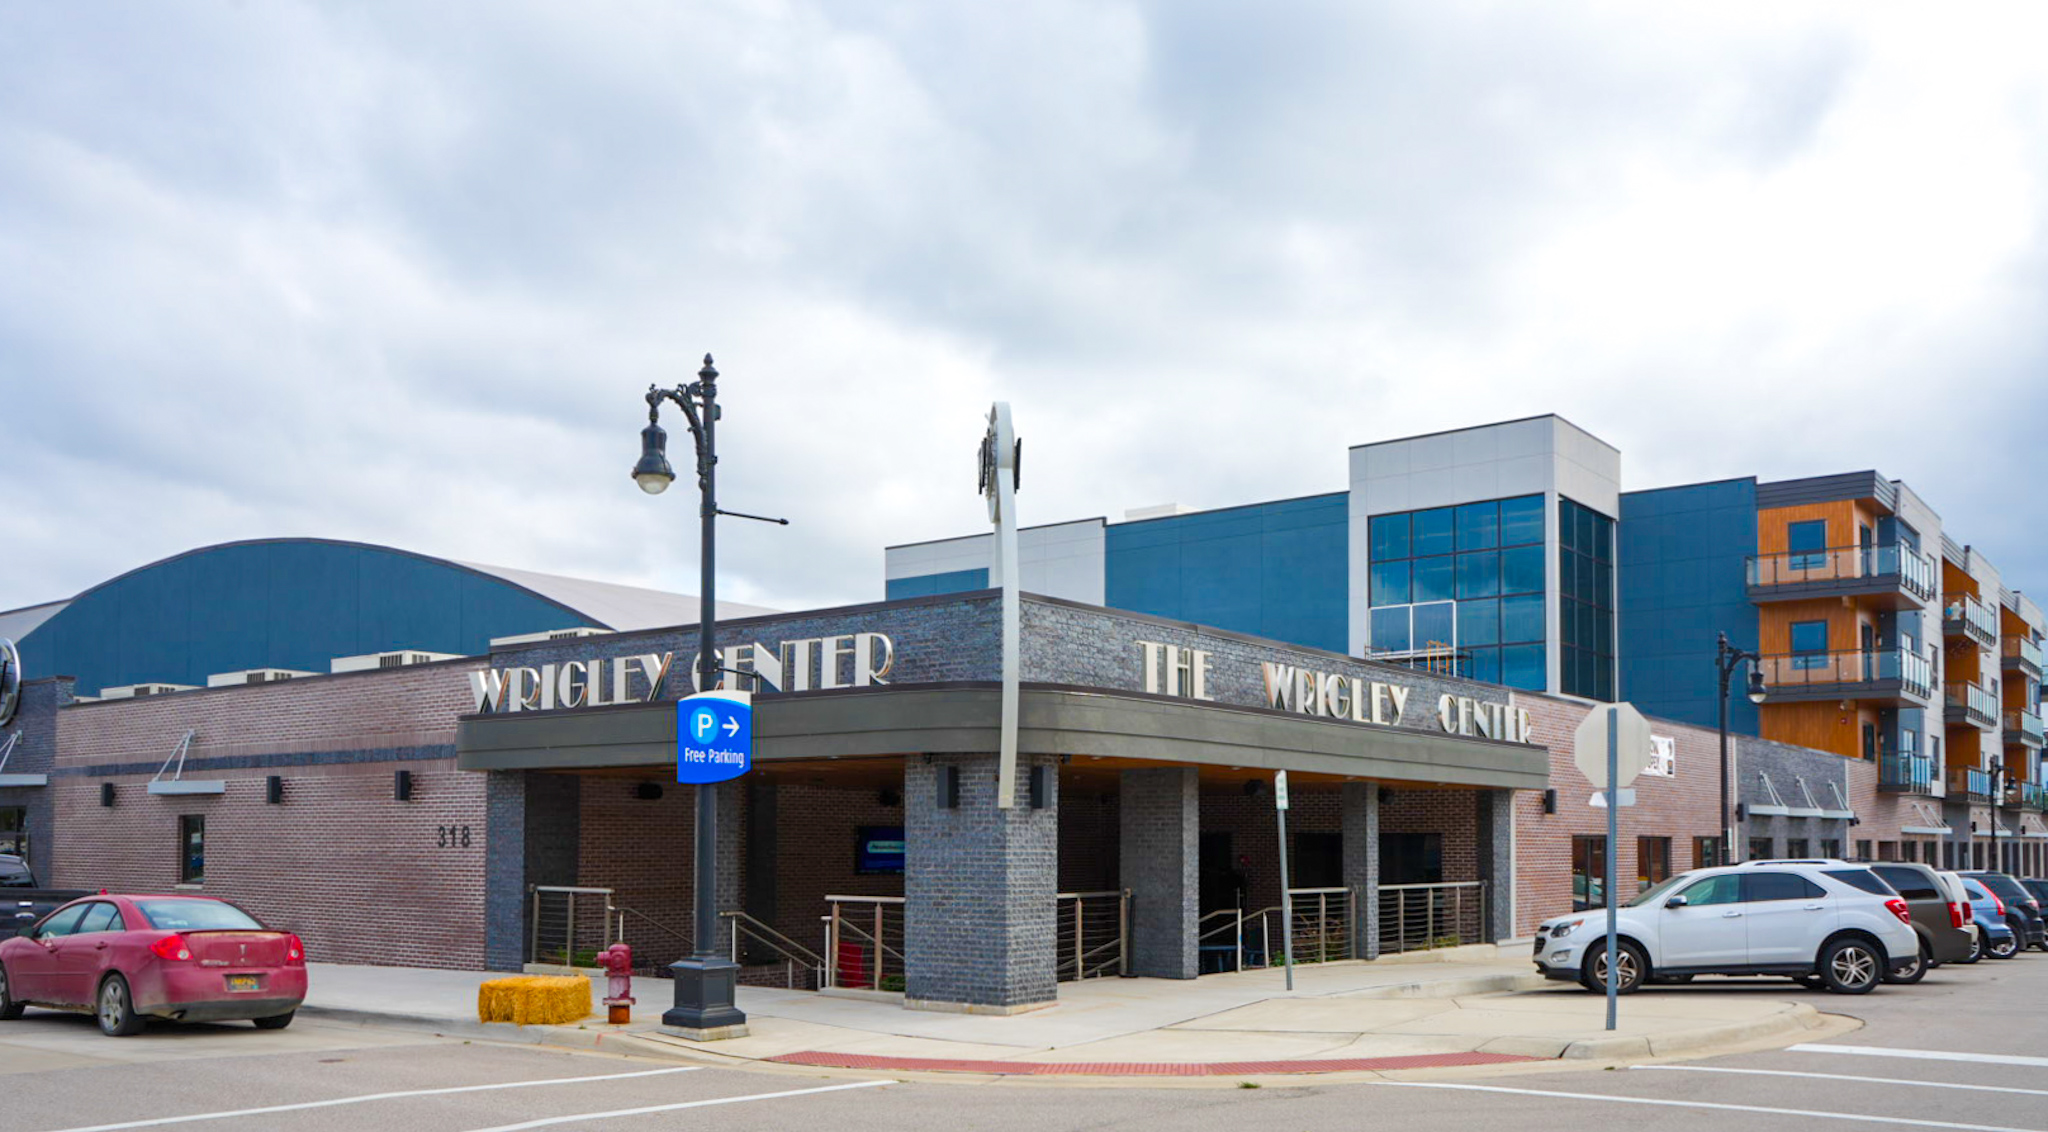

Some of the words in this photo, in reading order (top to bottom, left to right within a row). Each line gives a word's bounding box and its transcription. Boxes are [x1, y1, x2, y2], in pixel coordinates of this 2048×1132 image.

[468, 652, 672, 713] WRIGLEY
[1135, 640, 1214, 701] THE
[1261, 662, 1409, 726] WRIGLEY
[1438, 694, 1532, 743] CENTER
[698, 713, 713, 738] P
[684, 747, 706, 763] Free
[708, 748, 745, 769] Parking
[438, 825, 471, 848] 318
